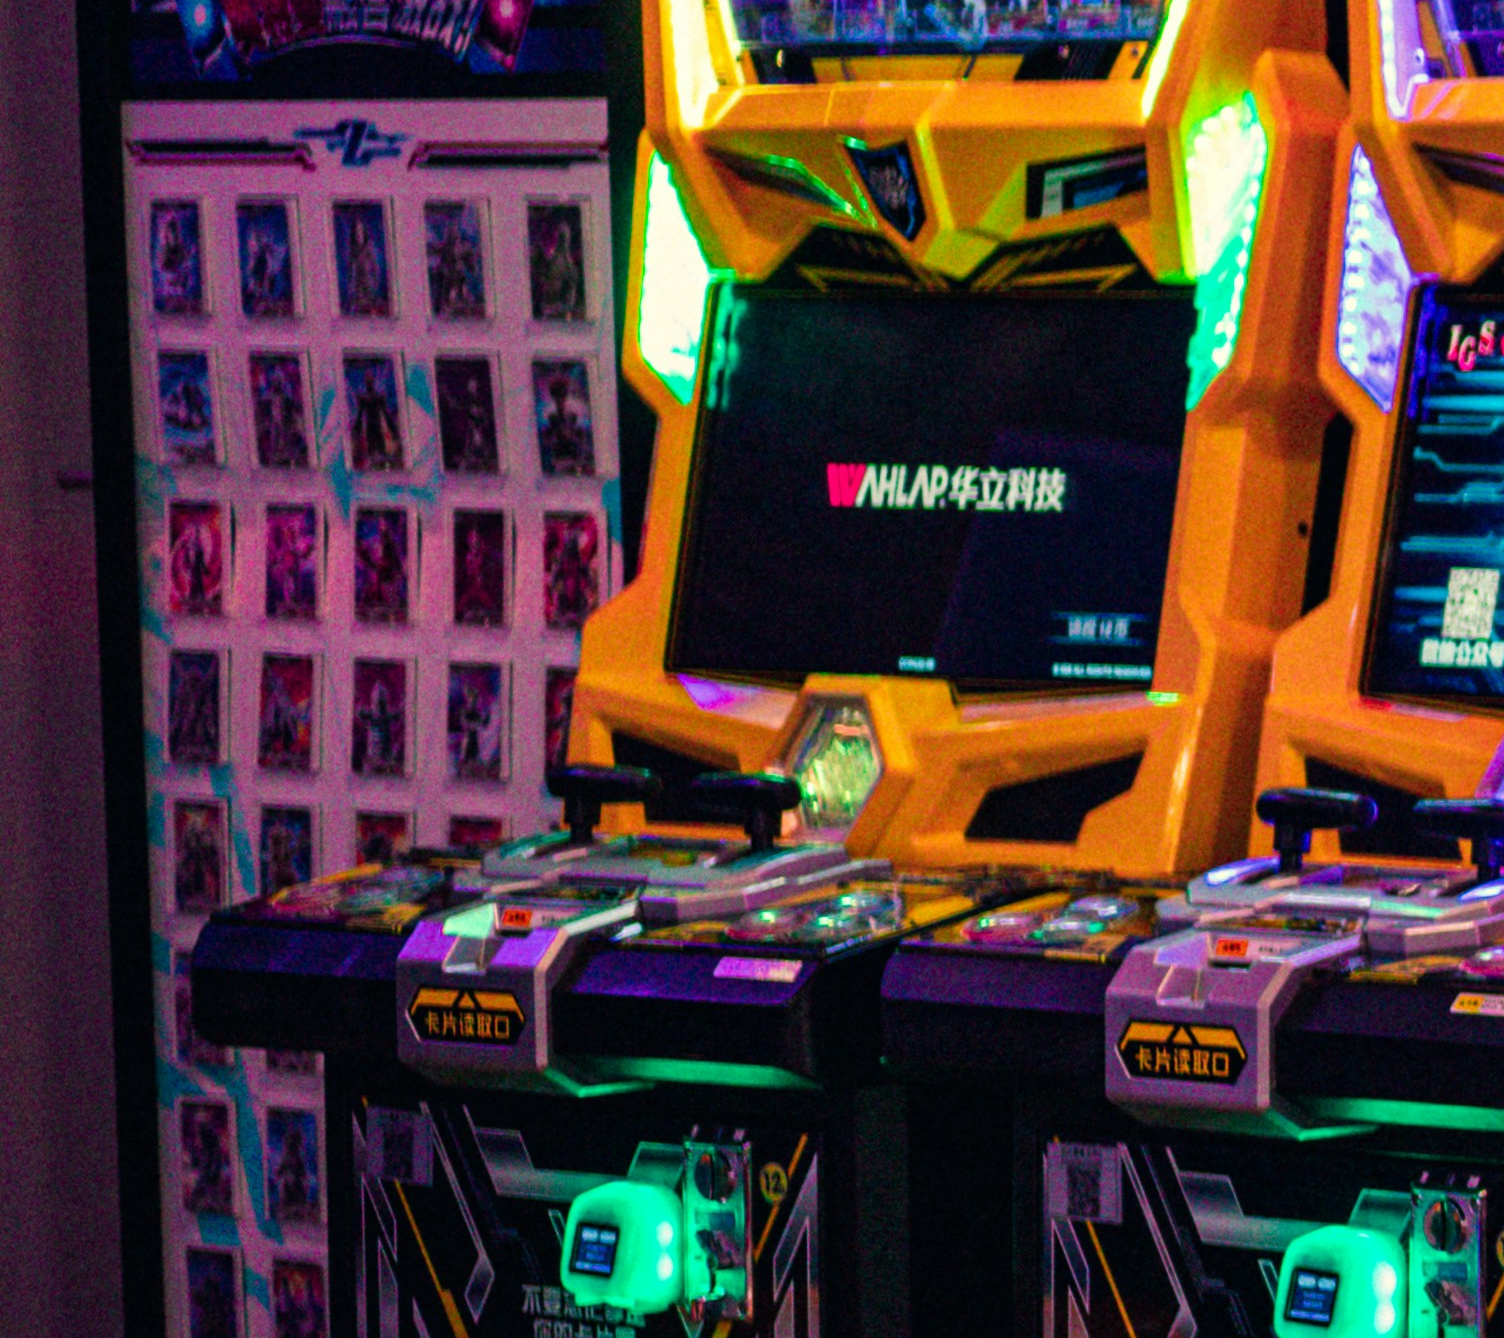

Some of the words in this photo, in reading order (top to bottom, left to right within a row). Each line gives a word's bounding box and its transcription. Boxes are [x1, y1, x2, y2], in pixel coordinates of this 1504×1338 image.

[949, 464, 1067, 514] 华立科技
[423, 1010, 513, 1041] 卡片读取口
[1133, 1046, 1231, 1078] 卡片读取口
